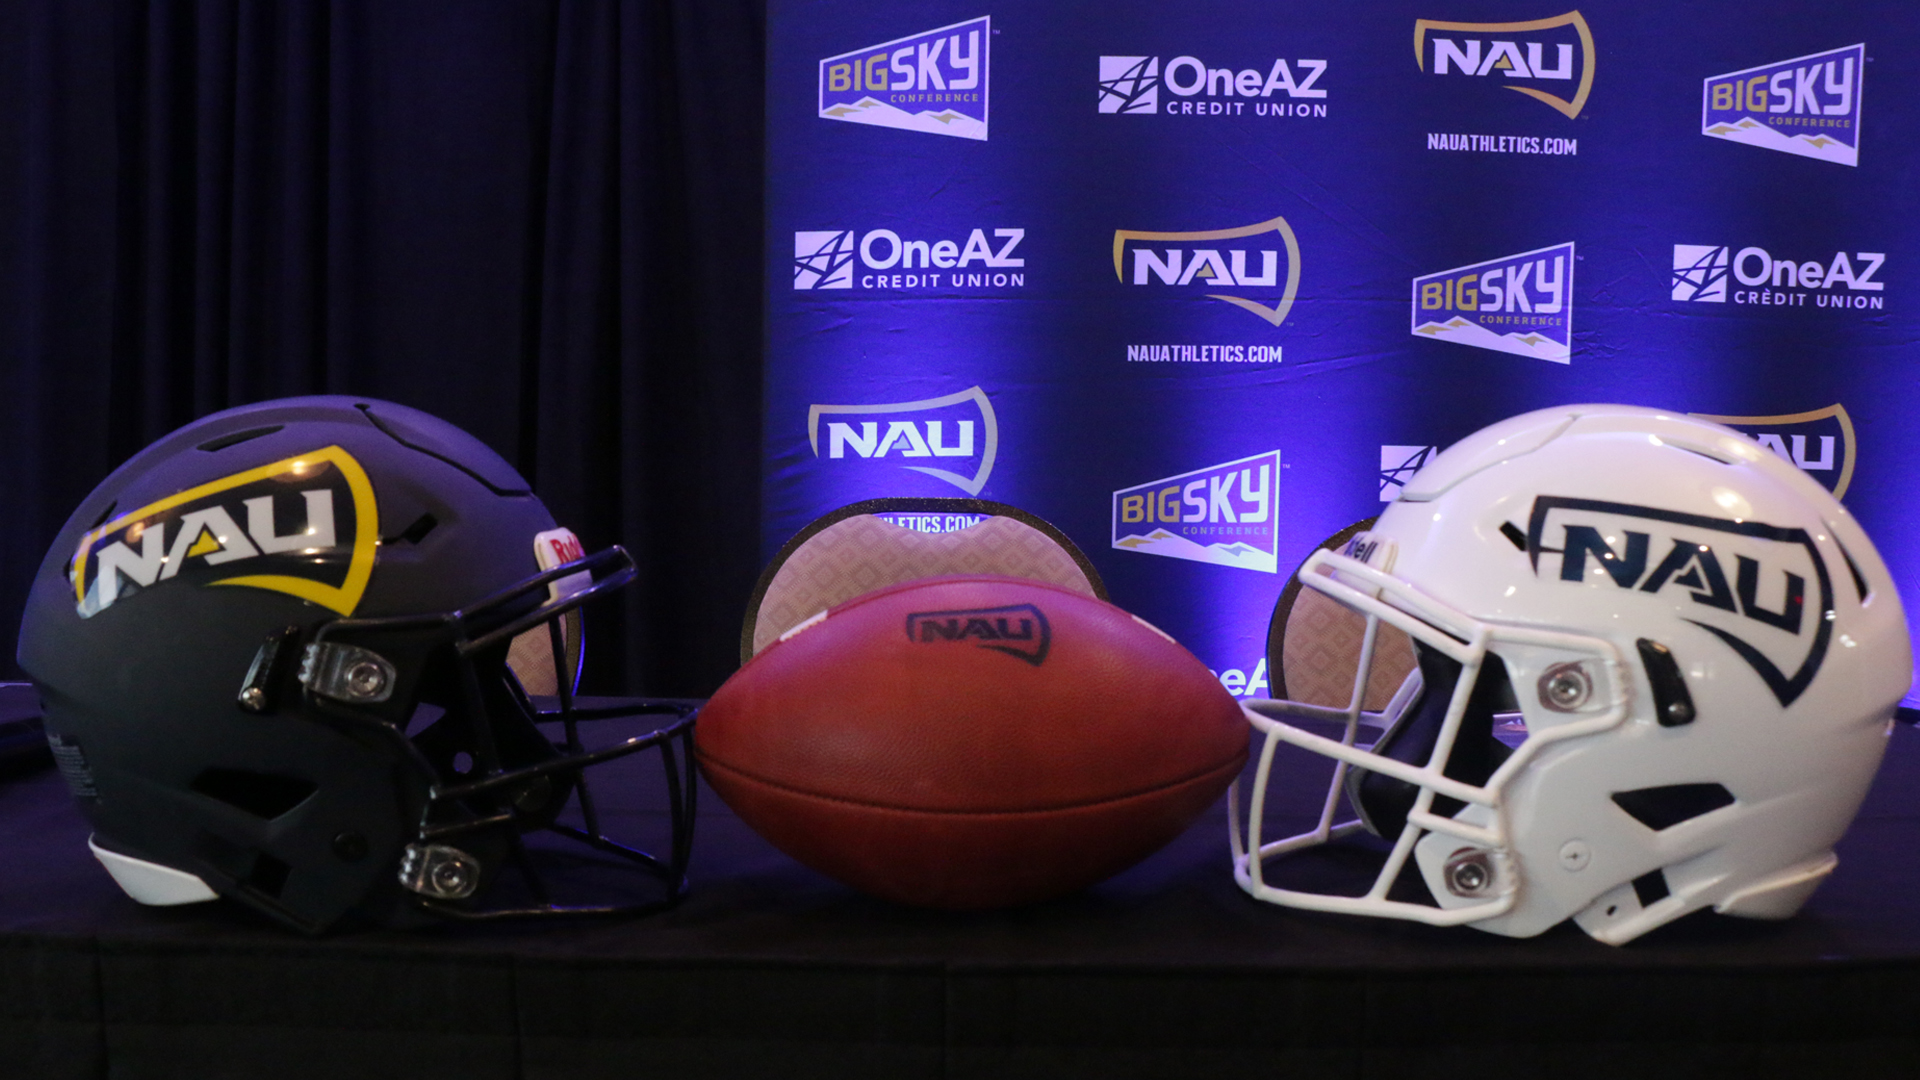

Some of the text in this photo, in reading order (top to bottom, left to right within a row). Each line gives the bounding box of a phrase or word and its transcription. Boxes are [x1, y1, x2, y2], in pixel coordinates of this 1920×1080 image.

[1432, 38, 1573, 80] NAU
[1164, 55, 1328, 99] OneAZ
[890, 93, 979, 104] CONFERENCE
[1166, 101, 1328, 118] CREDIT UNION
[1768, 116, 1851, 128] CONFERENCE
[1427, 132, 1578, 156] NAUATHLETICS.COM
[860, 228, 1025, 269] OneAZ
[861, 273, 1025, 289] CREDIT UNION
[1132, 248, 1278, 287] NAU
[1733, 246, 1886, 291] OneAZ
[1816, 294, 1884, 310] UNION
[1479, 314, 1563, 327] CONFERENCE
[1127, 344, 1283, 363] NAUATHLETICS.COM
[827, 420, 974, 459] NAU
[1742, 432, 1835, 471] AU
[1182, 526, 1269, 536] CONFERENCE
[95, 488, 337, 608] NAU
[1560, 523, 1806, 637] NAU
[920, 617, 1033, 644] NAU
